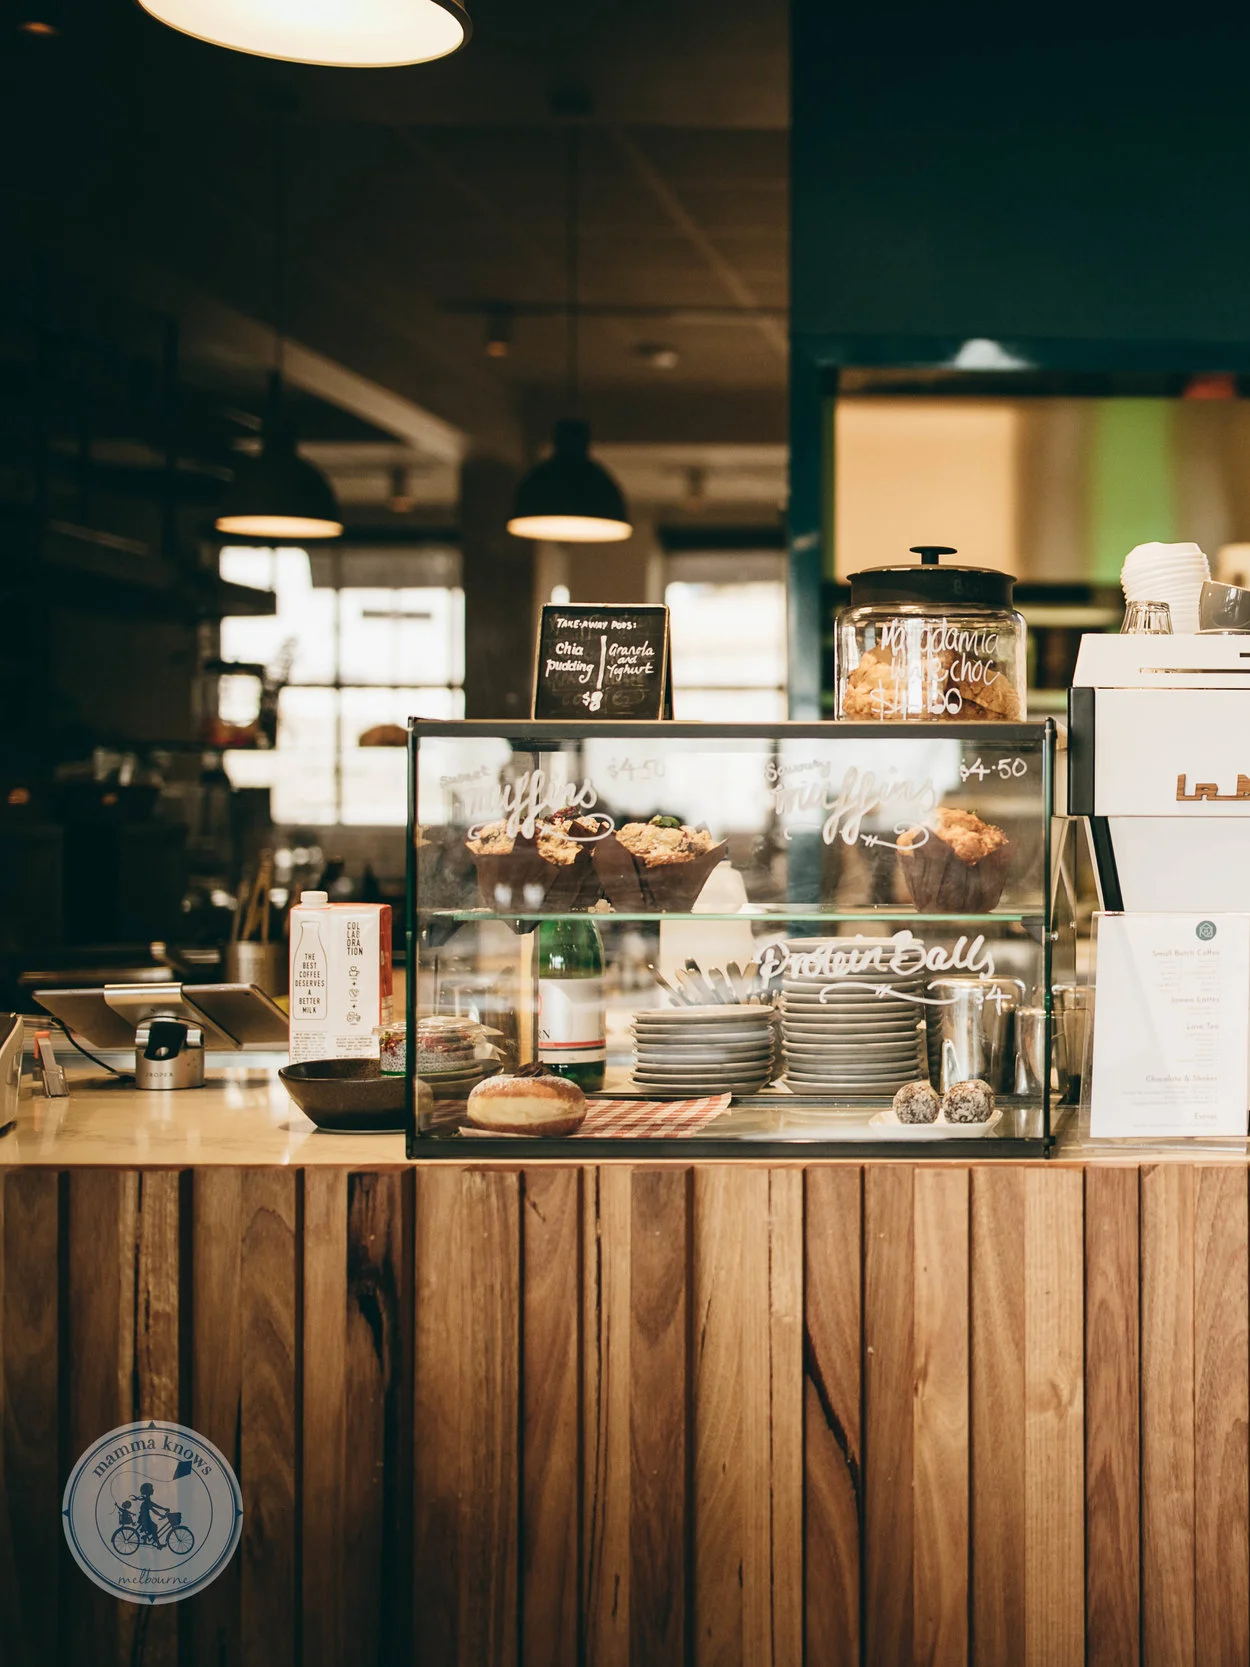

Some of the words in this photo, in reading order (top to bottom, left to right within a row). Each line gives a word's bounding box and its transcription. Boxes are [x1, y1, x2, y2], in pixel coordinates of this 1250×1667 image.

[608, 640, 656, 656] Granola
[880, 617, 1000, 657] Maadamia
[556, 641, 584, 656] Chia
[618, 656, 638, 664] and
[950, 652, 1001, 686] choc
[545, 659, 594, 684] pudding
[607, 662, 655, 682] Yoghurt
[582, 690, 604, 712] $8
[346, 922, 360, 930] COL
[753, 934, 888, 988] Protein
[890, 930, 996, 980] Balls
[974, 984, 1012, 1016] $4
